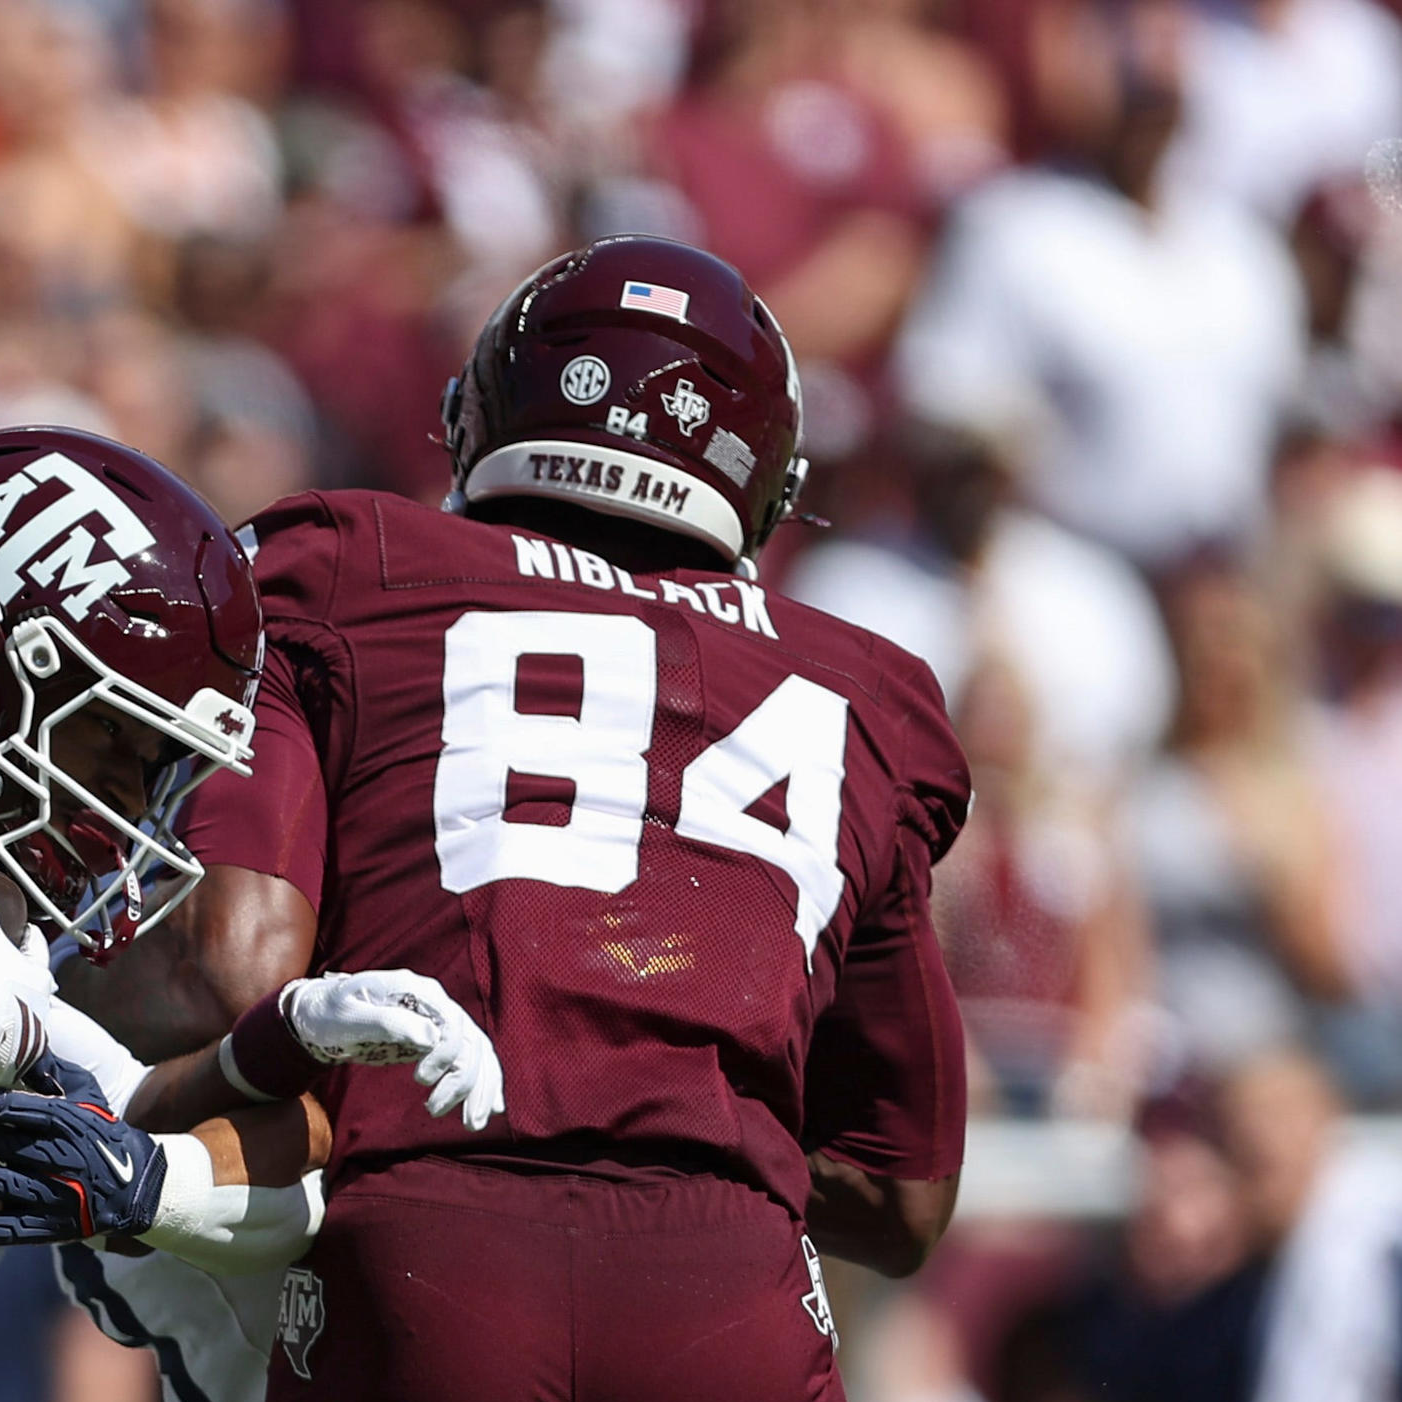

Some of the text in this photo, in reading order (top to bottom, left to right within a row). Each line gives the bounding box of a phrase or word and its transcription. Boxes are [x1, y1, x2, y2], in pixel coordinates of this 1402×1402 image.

[564, 359, 607, 401] SEC
[605, 405, 649, 440] 84
[529, 453, 692, 513] TEXAS A&M
[511, 534, 780, 640] NIBLACK
[433, 611, 849, 976] 84
